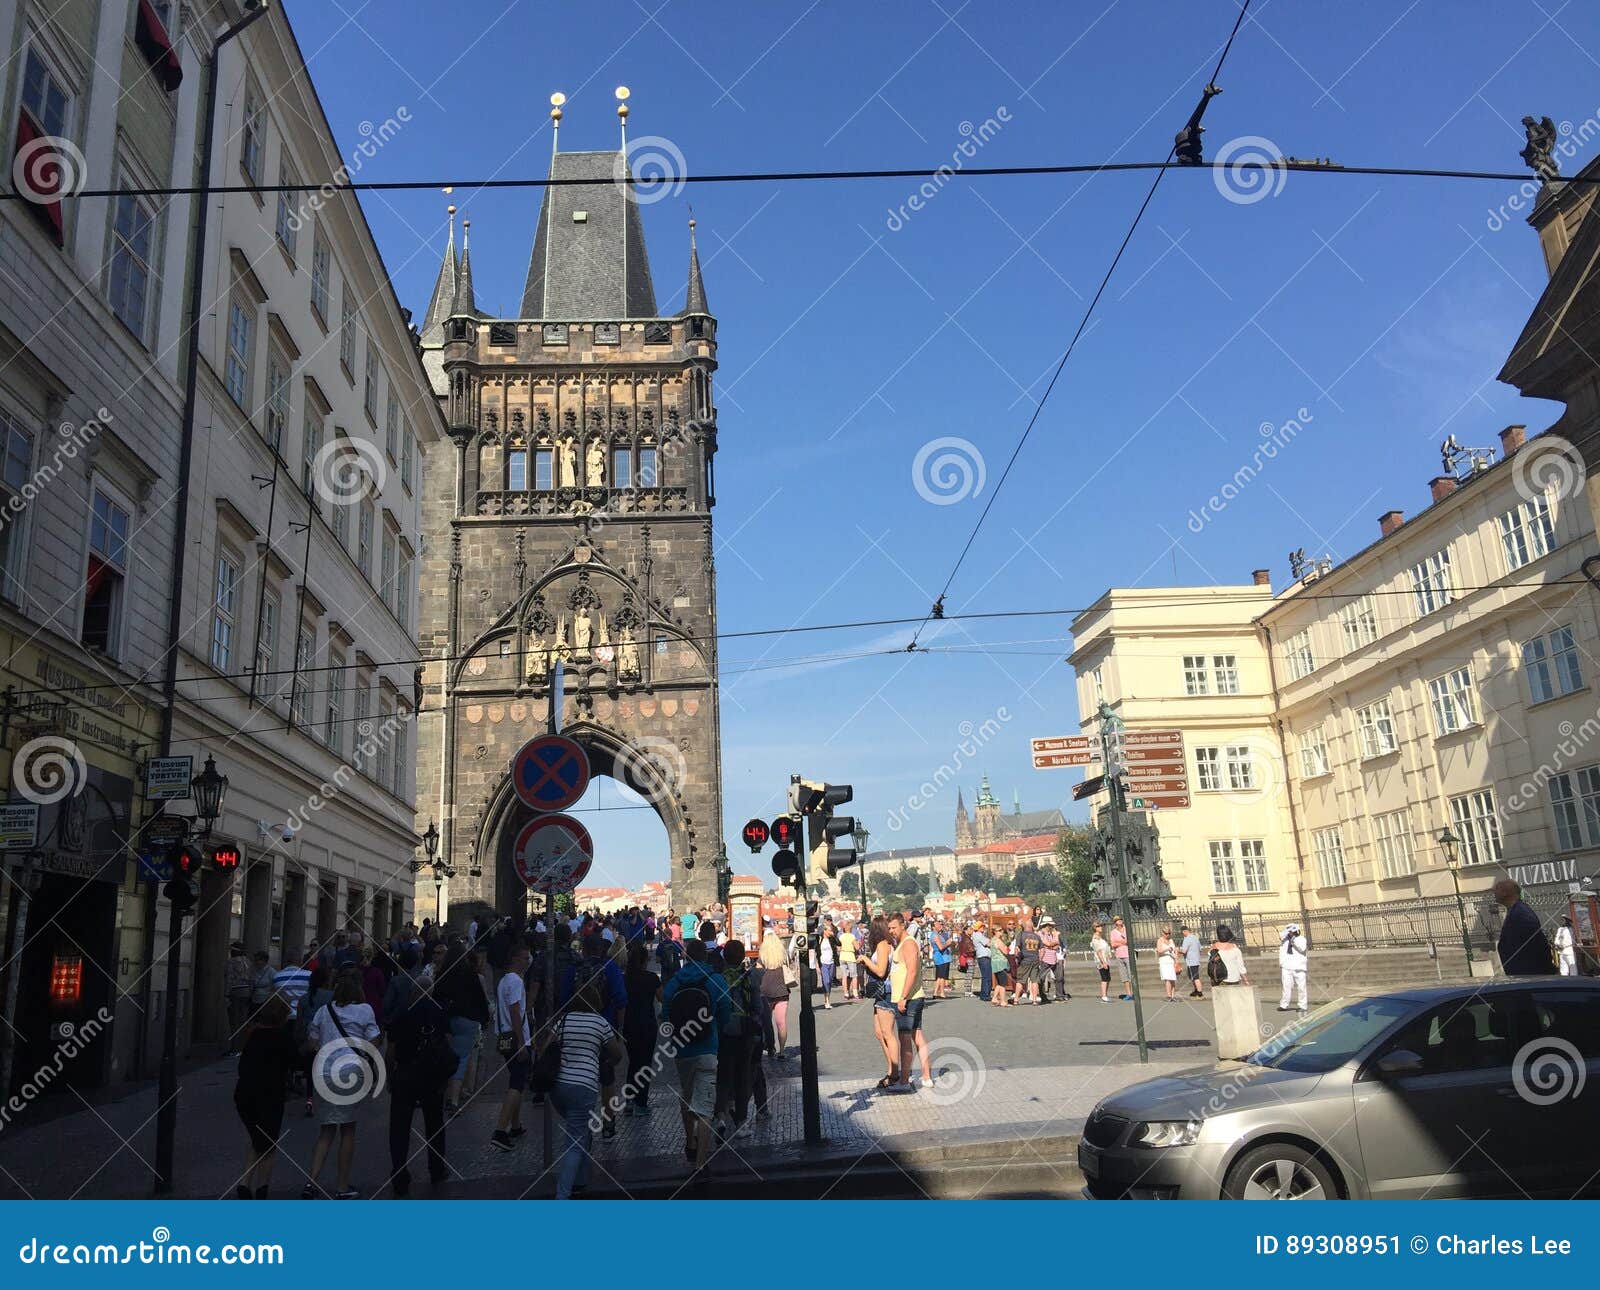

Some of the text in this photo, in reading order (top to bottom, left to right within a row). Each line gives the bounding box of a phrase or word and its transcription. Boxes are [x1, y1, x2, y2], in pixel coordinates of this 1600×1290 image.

[1135, 799, 1142, 807] A
[745, 826, 766, 841] 44
[215, 851, 237, 867] 44
[1507, 859, 1579, 885] MUZEUM
